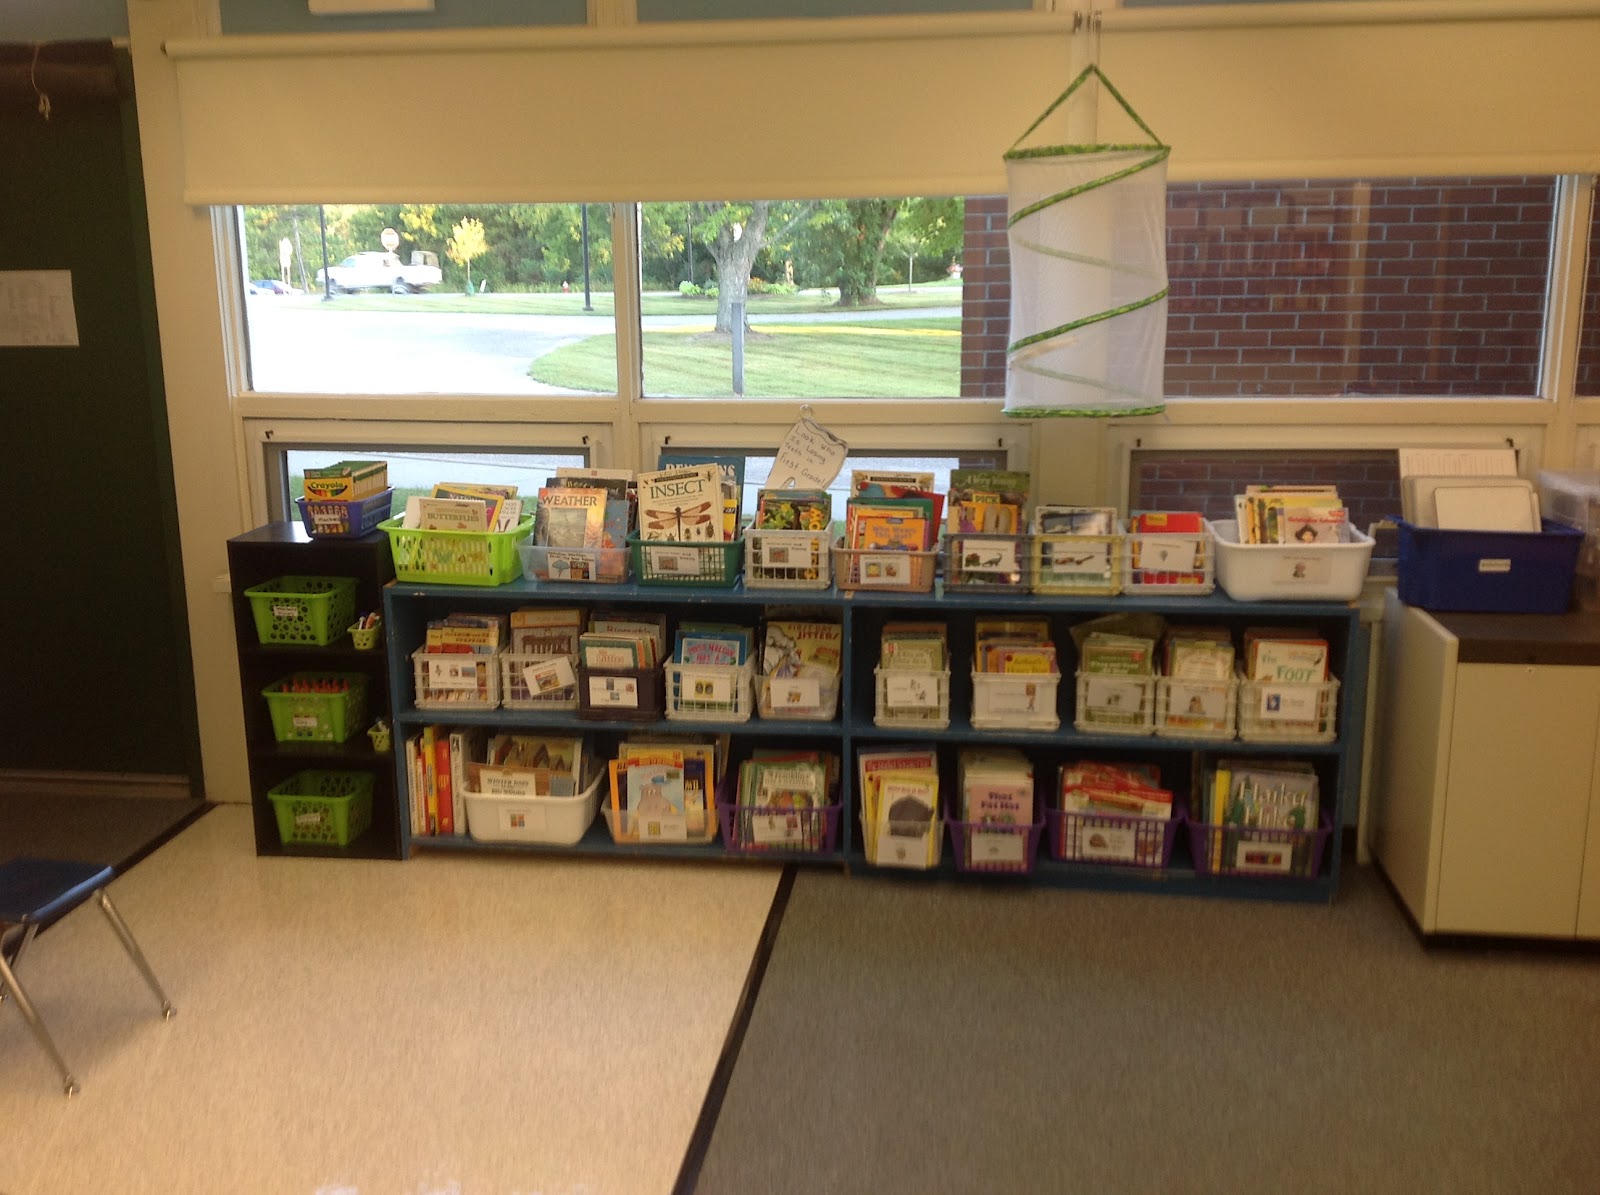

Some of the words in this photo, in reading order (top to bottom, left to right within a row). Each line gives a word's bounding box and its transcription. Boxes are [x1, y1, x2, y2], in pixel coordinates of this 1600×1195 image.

[795, 425, 815, 445] Look
[779, 451, 800, 471] First
[310, 481, 344, 489] Crayola
[650, 479, 706, 499] INSECT
[542, 495, 598, 507] WEATHER
[427, 512, 480, 522] BUTTERFLIES
[796, 631, 840, 640] JITTERS
[1277, 665, 1318, 683] FOOT
